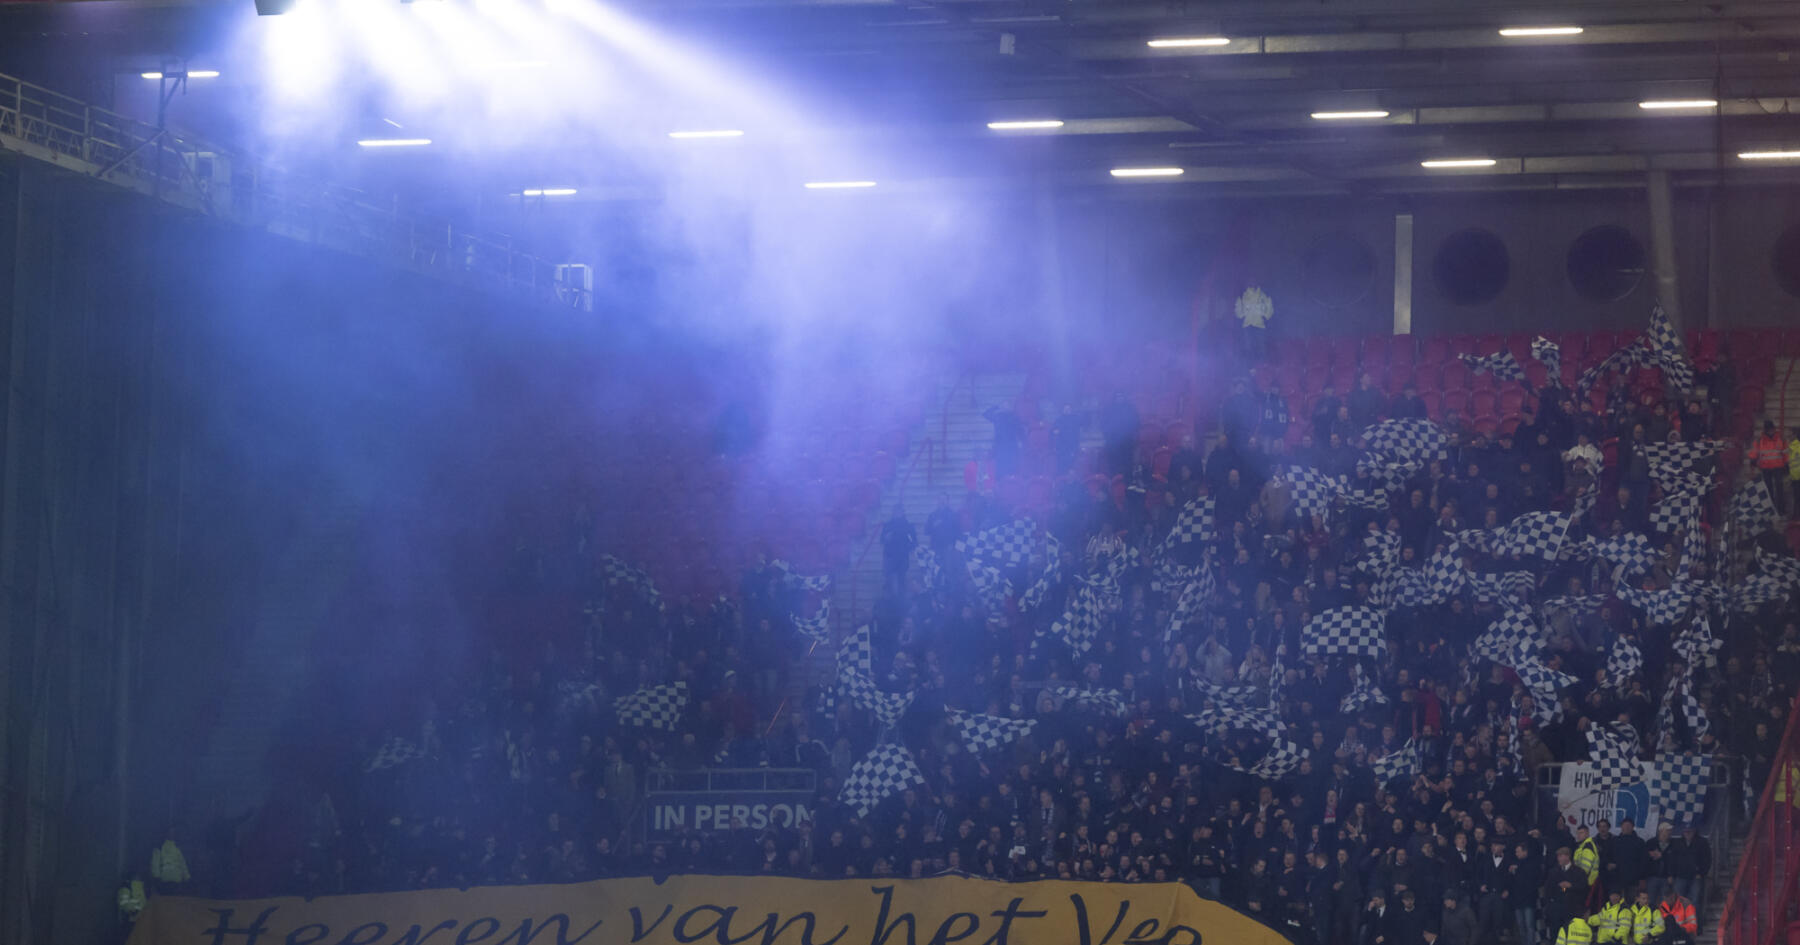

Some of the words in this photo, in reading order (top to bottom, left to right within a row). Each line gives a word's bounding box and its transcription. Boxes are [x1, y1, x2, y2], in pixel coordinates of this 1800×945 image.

[1574, 771, 1594, 788] HV
[1598, 790, 1616, 809] ON
[655, 805, 686, 830] IN
[695, 803, 816, 830] PERSON
[202, 906, 603, 945] Heeren
[629, 904, 848, 945] van
[871, 885, 1048, 945] het
